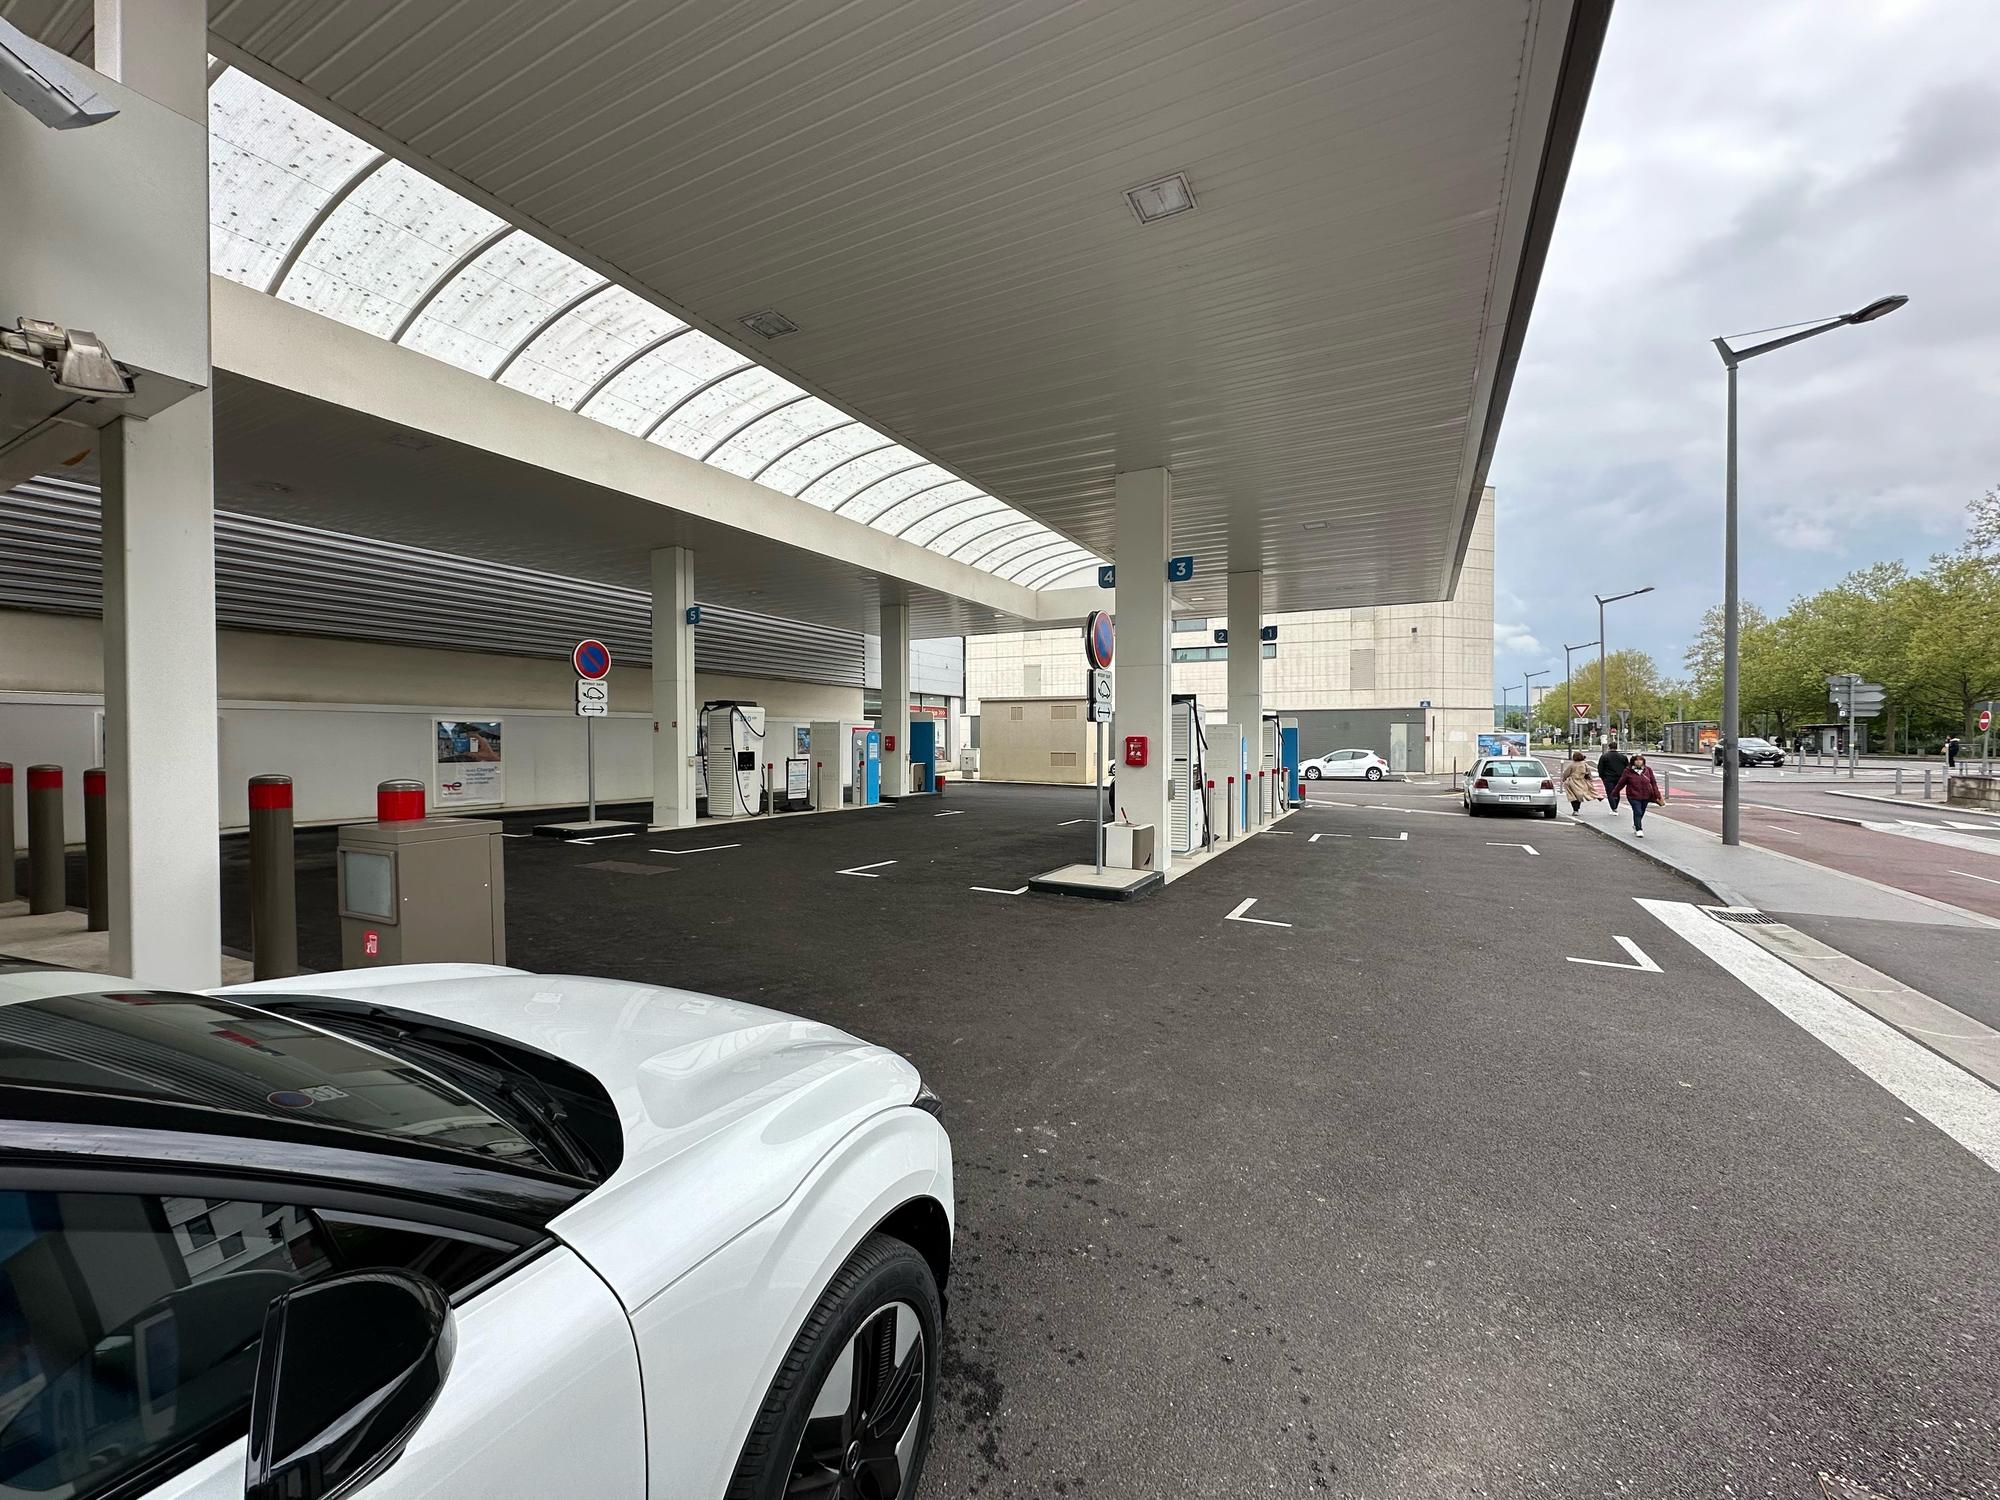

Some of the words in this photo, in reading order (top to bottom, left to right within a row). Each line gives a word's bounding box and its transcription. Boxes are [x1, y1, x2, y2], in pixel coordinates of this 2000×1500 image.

[1176, 562, 1187, 576] 3
[1104, 570, 1114, 583] 4
[690, 610, 696, 621] 5
[1218, 632, 1225, 641] 2
